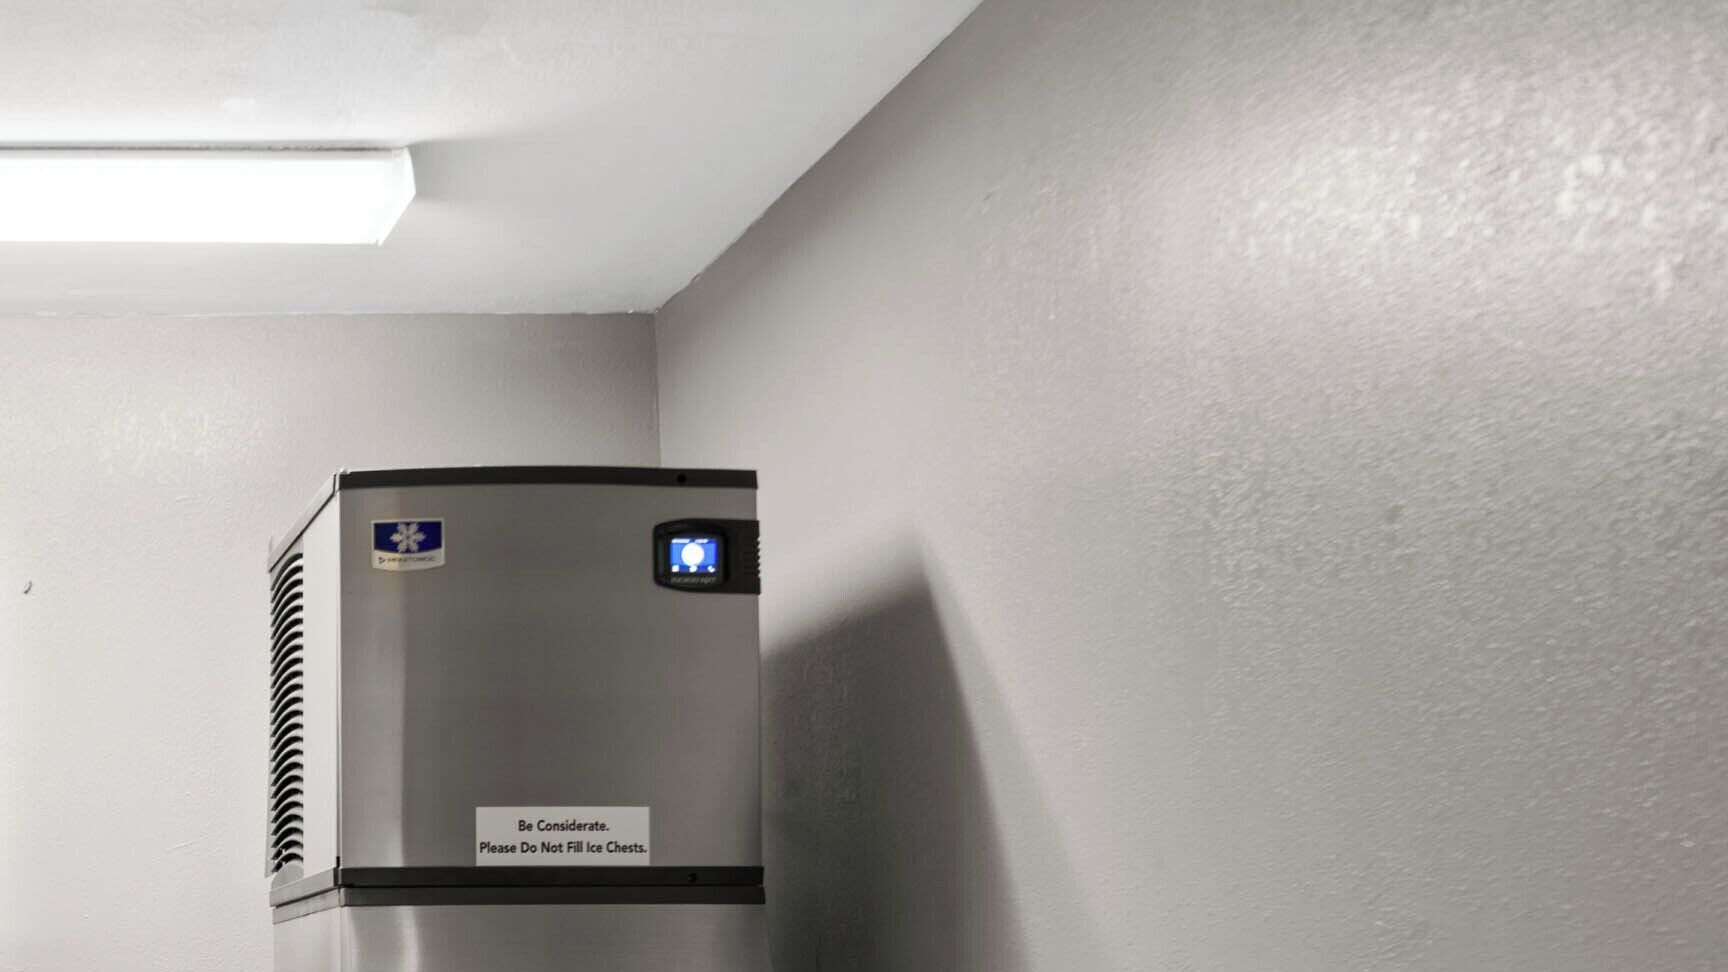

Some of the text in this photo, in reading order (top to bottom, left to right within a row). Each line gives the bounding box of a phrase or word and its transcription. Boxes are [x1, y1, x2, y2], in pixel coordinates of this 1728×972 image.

[518, 820, 610, 832] Be Considerate.
[479, 842, 647, 854] Please Do Not Fill Ice Chests.
